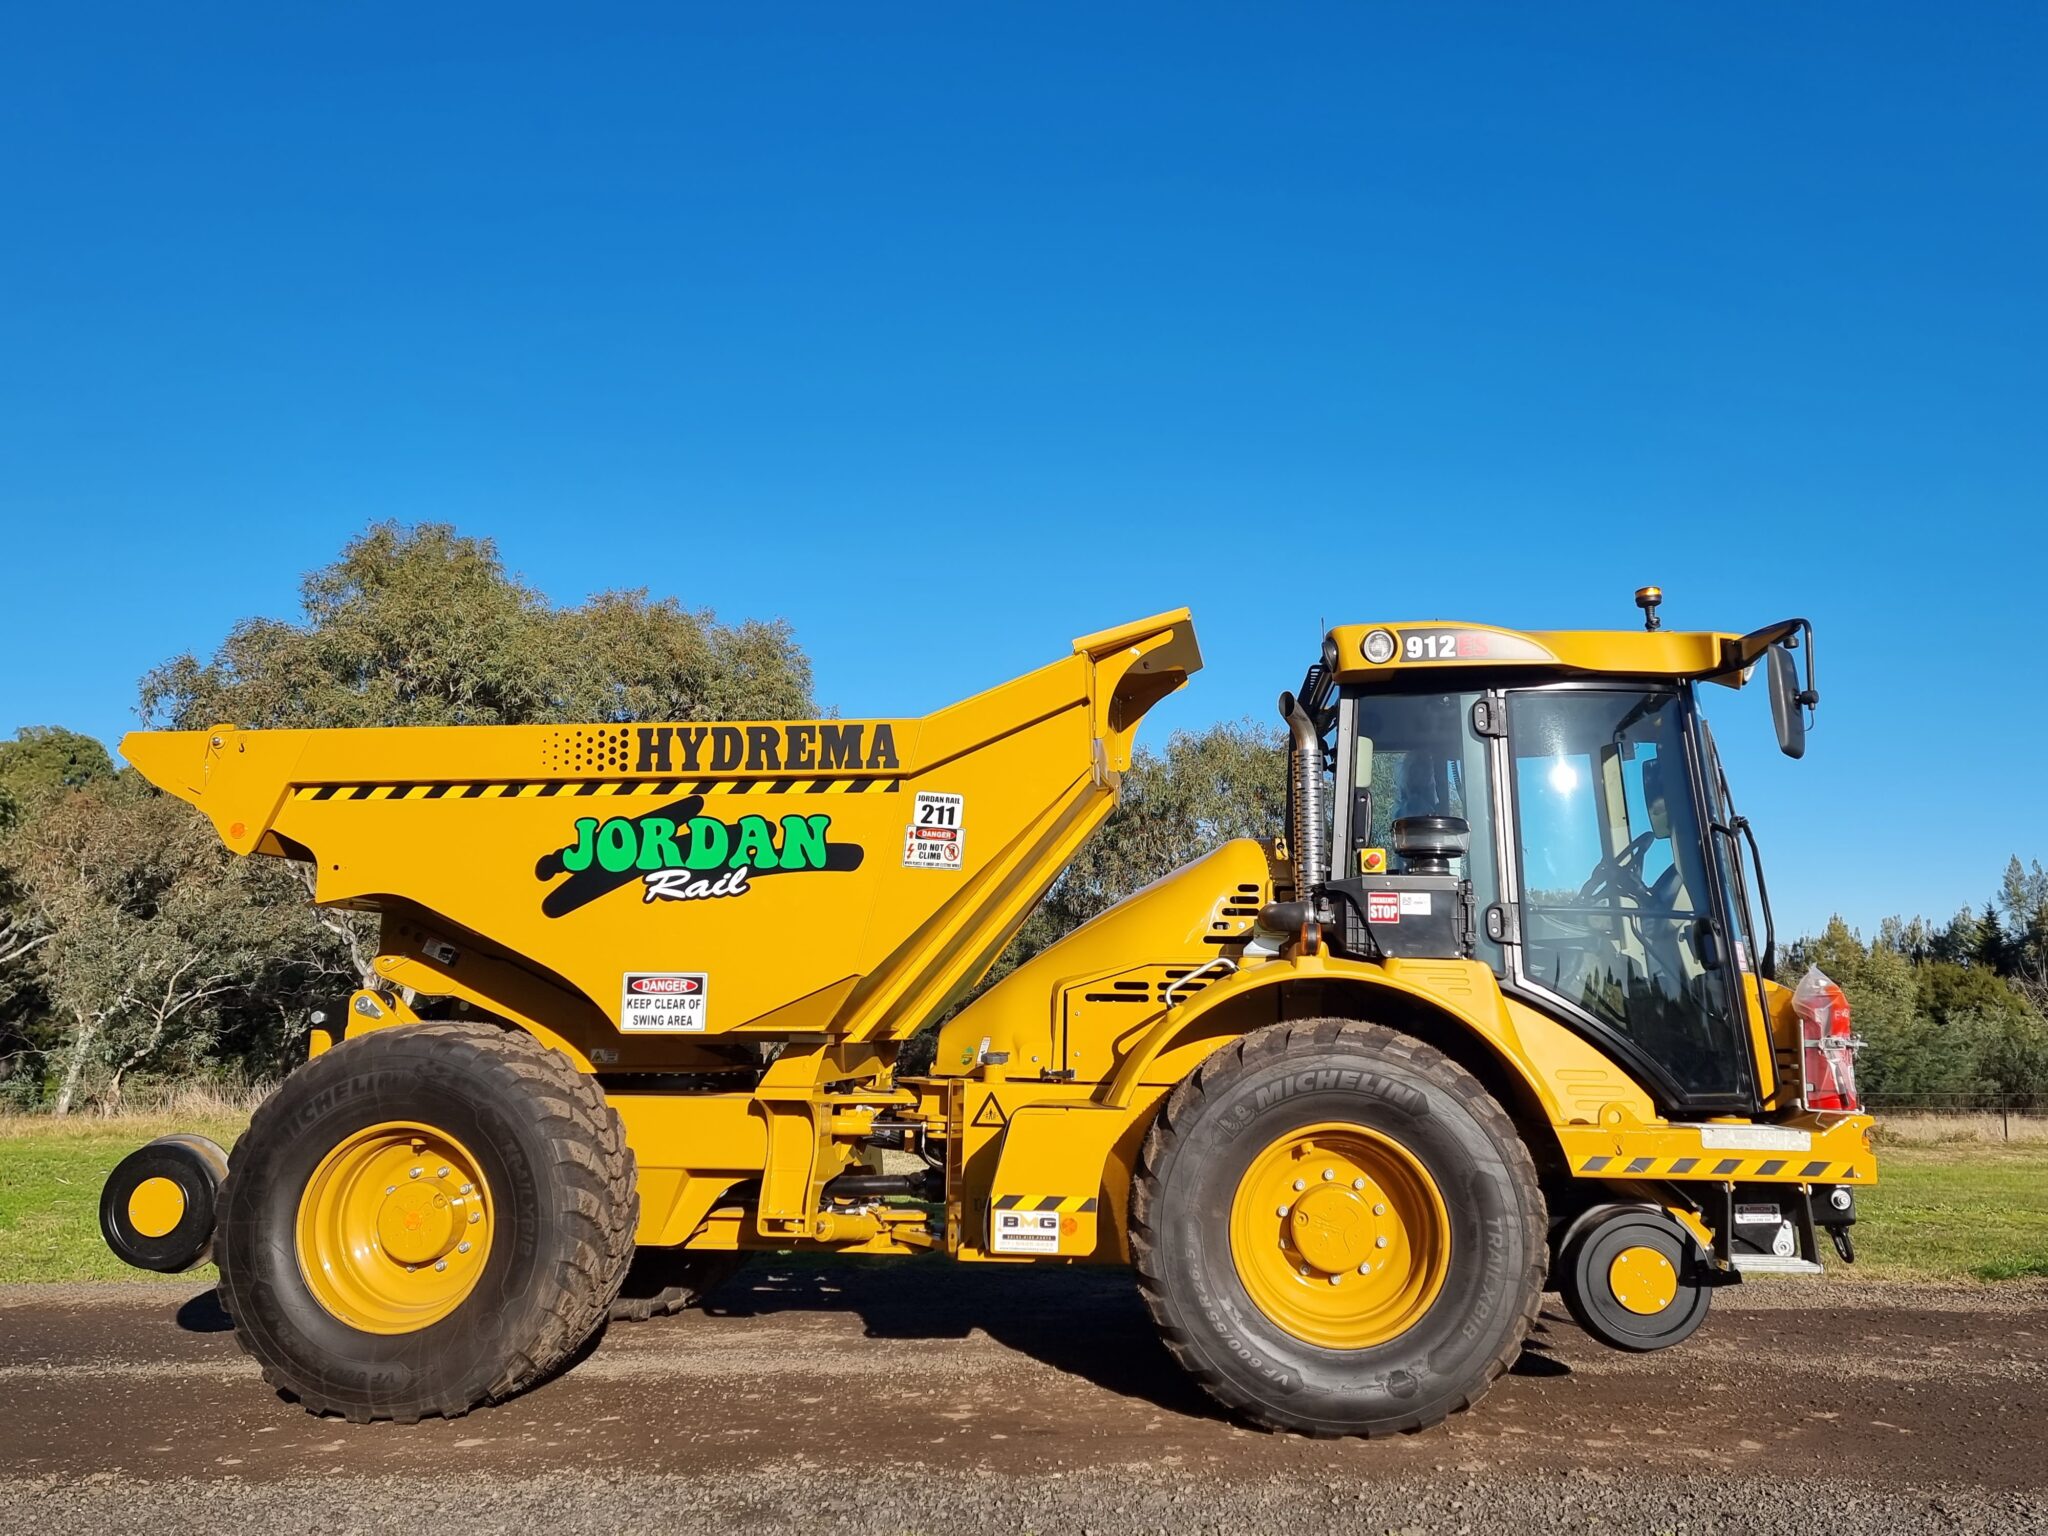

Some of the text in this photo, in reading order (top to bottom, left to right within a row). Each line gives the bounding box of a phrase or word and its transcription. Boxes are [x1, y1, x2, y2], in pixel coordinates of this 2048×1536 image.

[635, 724, 900, 772] HYDREMA
[917, 794, 944, 803] JORDAN
[920, 804, 955, 826] 211
[921, 831, 951, 839] DANGER
[562, 815, 831, 873] JORDAN
[917, 842, 944, 852] DO NOT
[918, 851, 942, 860] CLIMB
[645, 866, 748, 902] Rail
[1370, 905, 1397, 919] STOP
[641, 980, 688, 992] DANGER
[626, 998, 702, 1010] KEEP CLEAR OF
[632, 1014, 693, 1026] SWING AREA
[1255, 1069, 1417, 1114] MICHELIN
[1003, 1215, 1056, 1228] BMG
